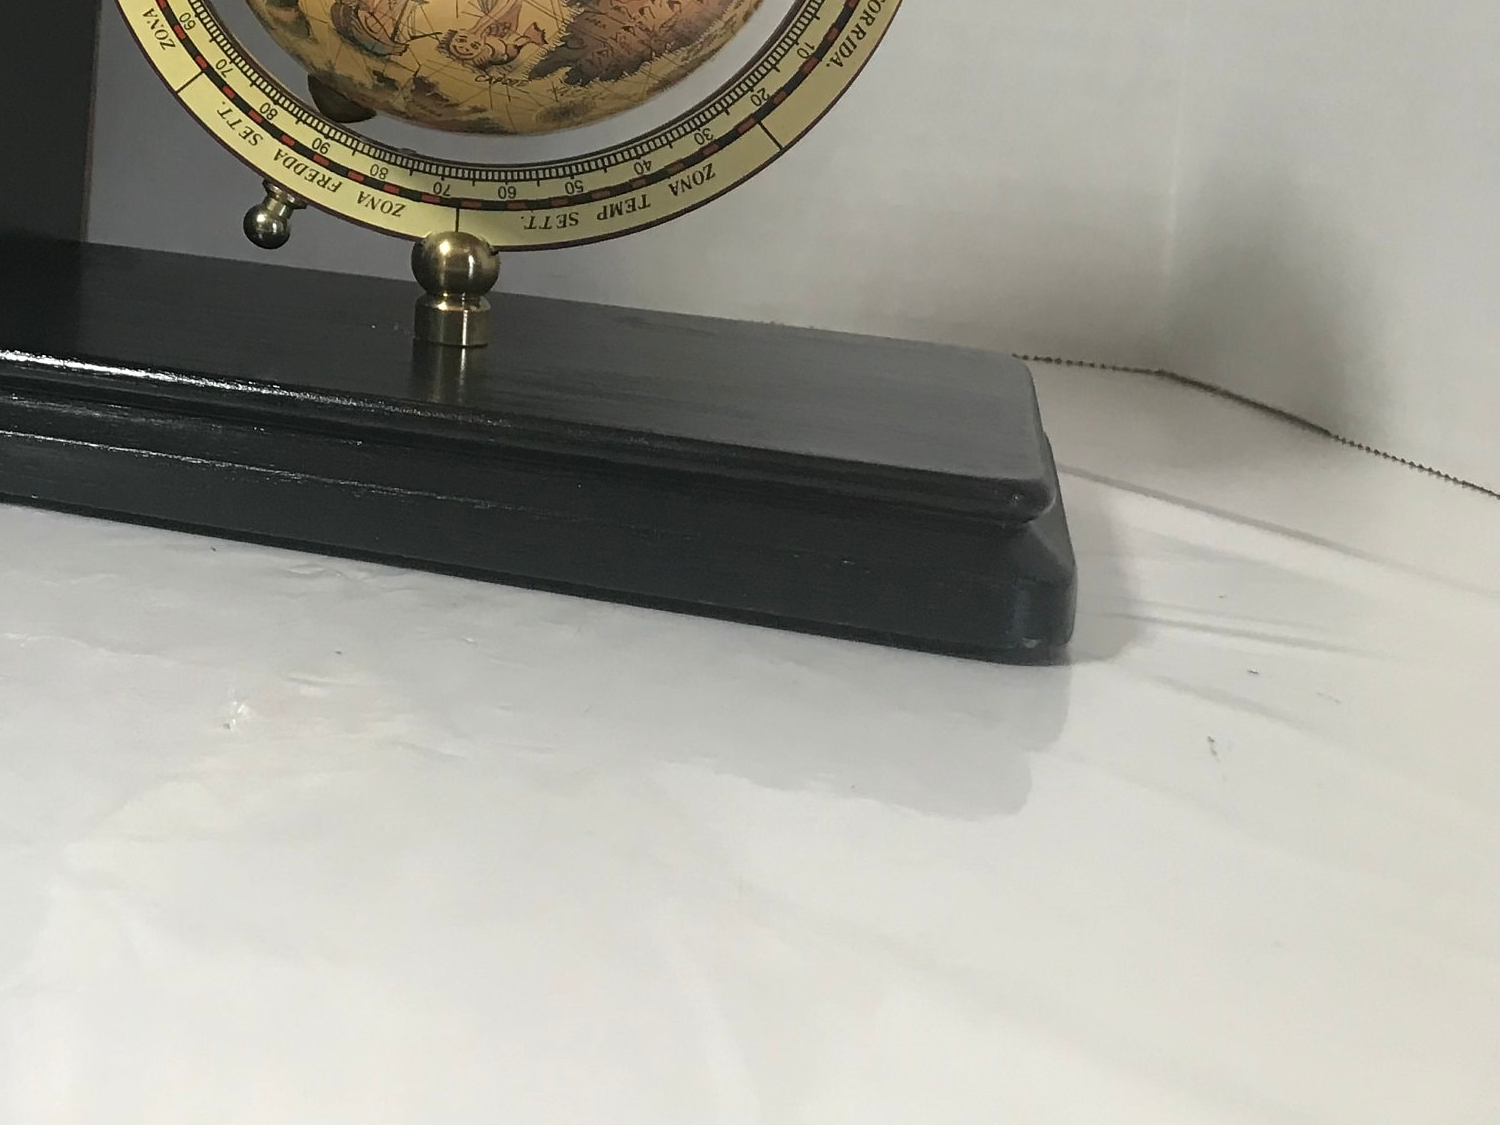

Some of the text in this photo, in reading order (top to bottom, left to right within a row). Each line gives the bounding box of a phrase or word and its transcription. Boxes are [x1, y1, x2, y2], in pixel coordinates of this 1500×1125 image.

[141, 7, 175, 50] ZONA
[179, 11, 196, 30] 60
[797, 41, 815, 60] 10
[215, 58, 235, 78] 70
[750, 87, 771, 107] 20
[259, 101, 278, 121] 80
[694, 127, 714, 145] 30
[311, 137, 331, 155] 90
[217, 100, 406, 218] ZONA FREDDA SETT.
[633, 159, 652, 175] 40
[369, 163, 389, 180] 80
[432, 180, 452, 197] 70
[497, 185, 517, 200] 60
[520, 162, 716, 230] ZONA TEMP SETT.
[565, 180, 584, 195] 50
